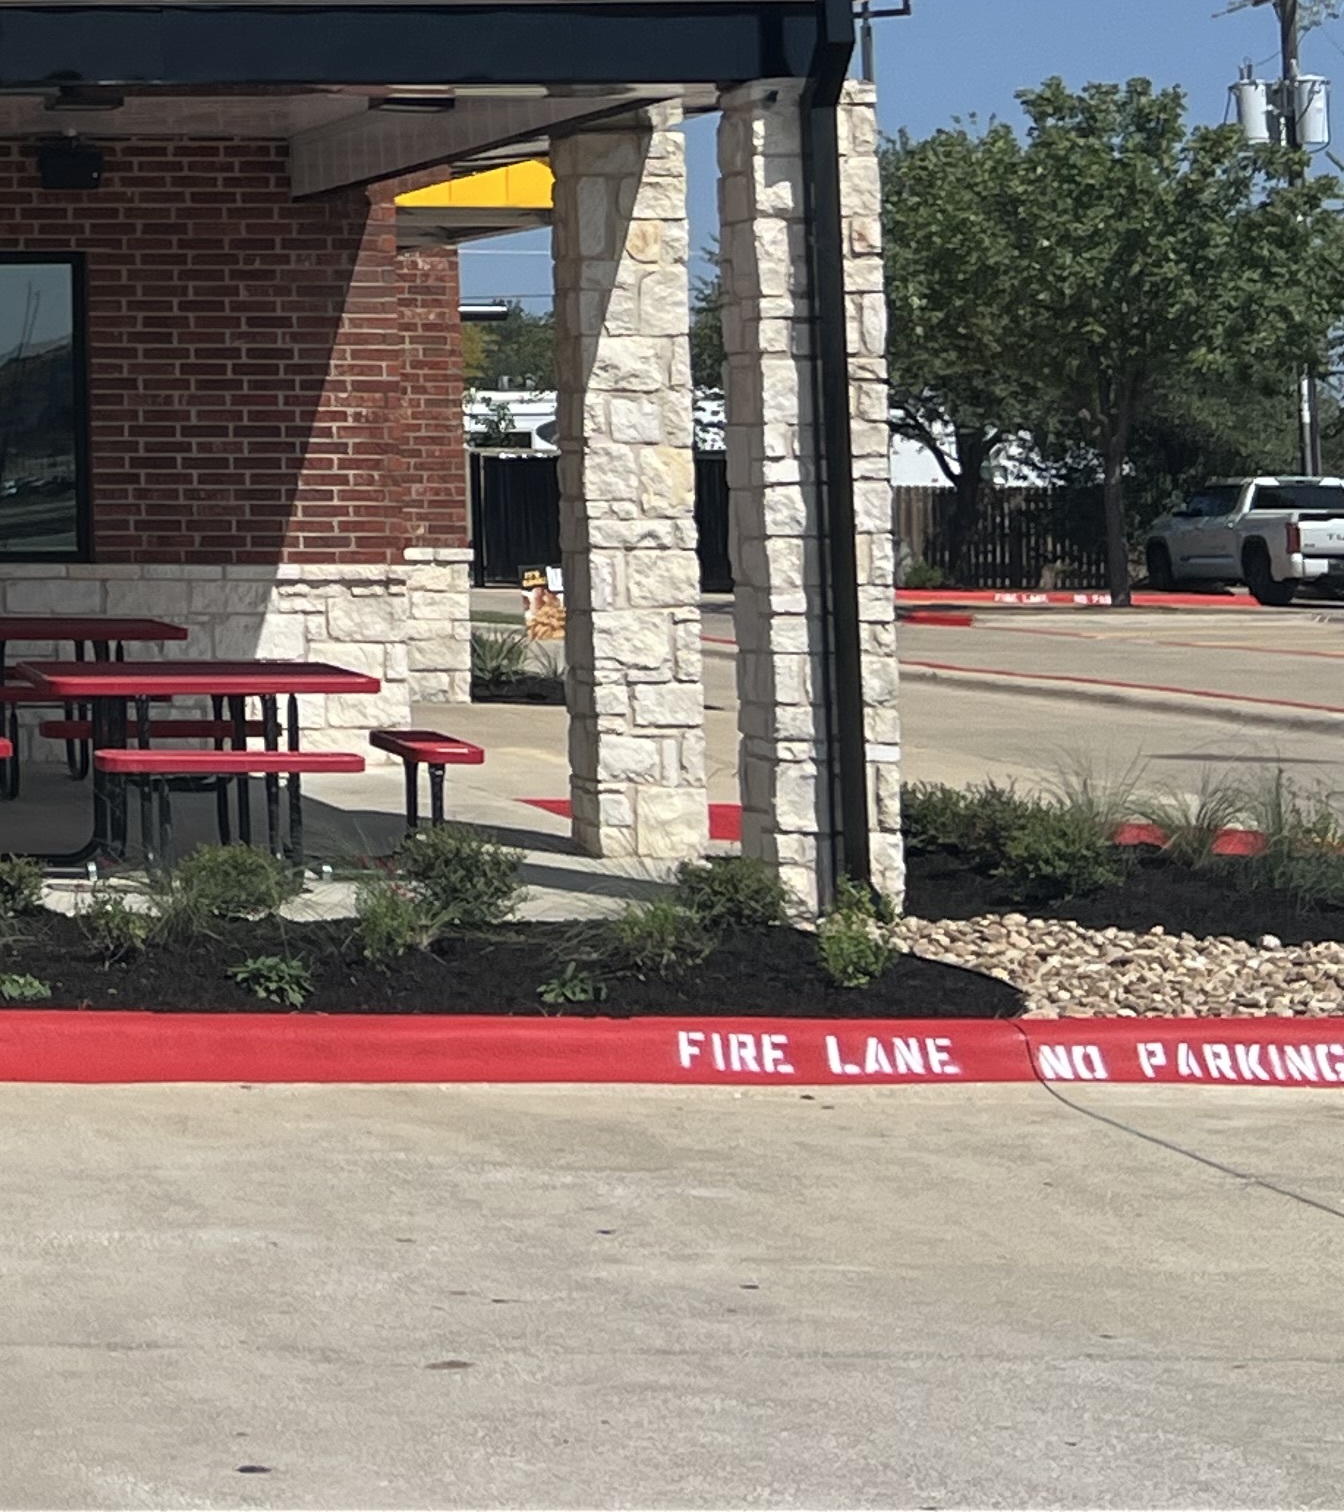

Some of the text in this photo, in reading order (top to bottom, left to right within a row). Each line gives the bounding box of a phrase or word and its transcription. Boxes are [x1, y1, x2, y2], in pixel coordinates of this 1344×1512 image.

[677, 1030, 961, 1076] FIRE LANE
[1037, 1042, 1344, 1082] NO PARKING
